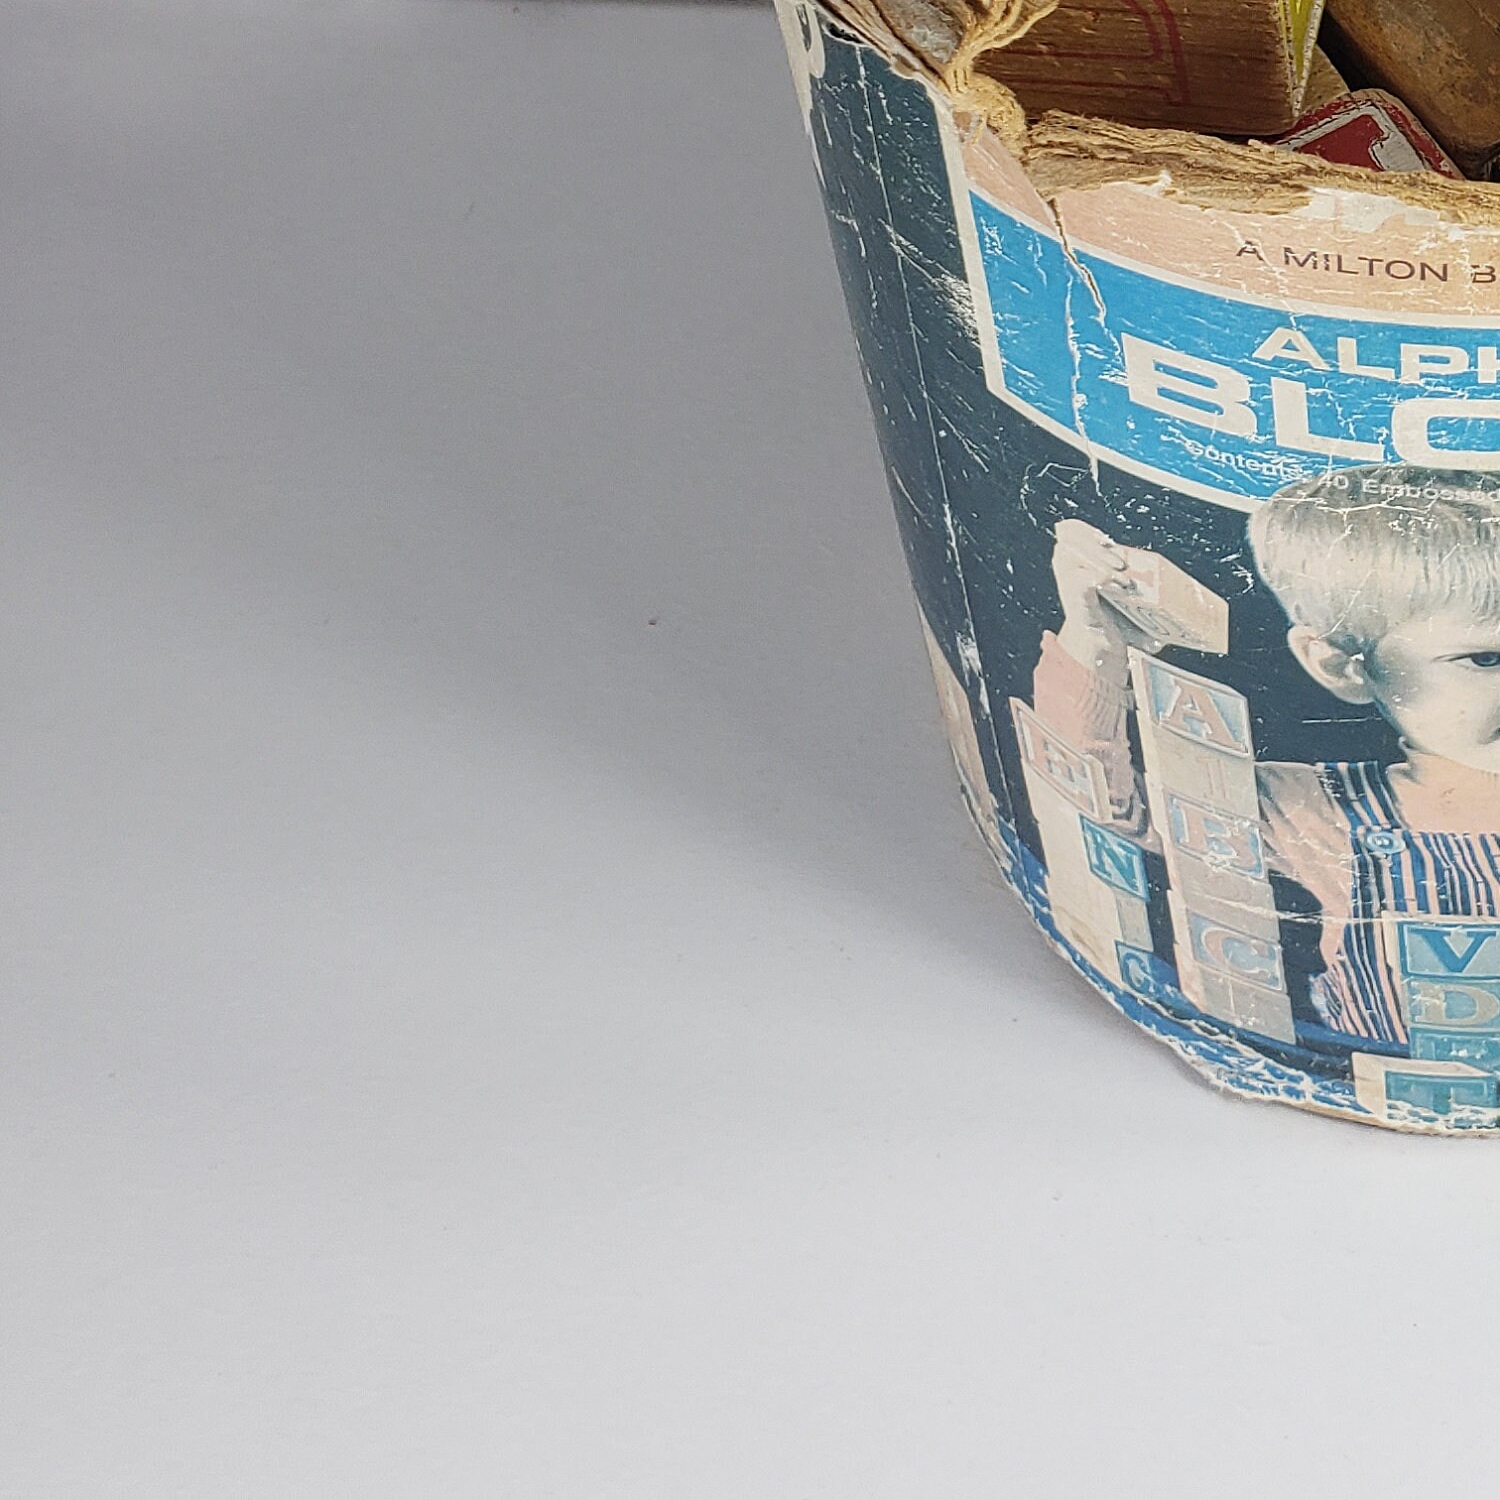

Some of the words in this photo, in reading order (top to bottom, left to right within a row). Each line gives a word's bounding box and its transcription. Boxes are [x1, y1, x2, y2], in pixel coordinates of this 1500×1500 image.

[1236, 240, 1265, 261] A
[1283, 247, 1450, 283] MILTON
[1157, 683, 1248, 754] A
[1407, 927, 1498, 974] V
[1411, 981, 1500, 1027] D
